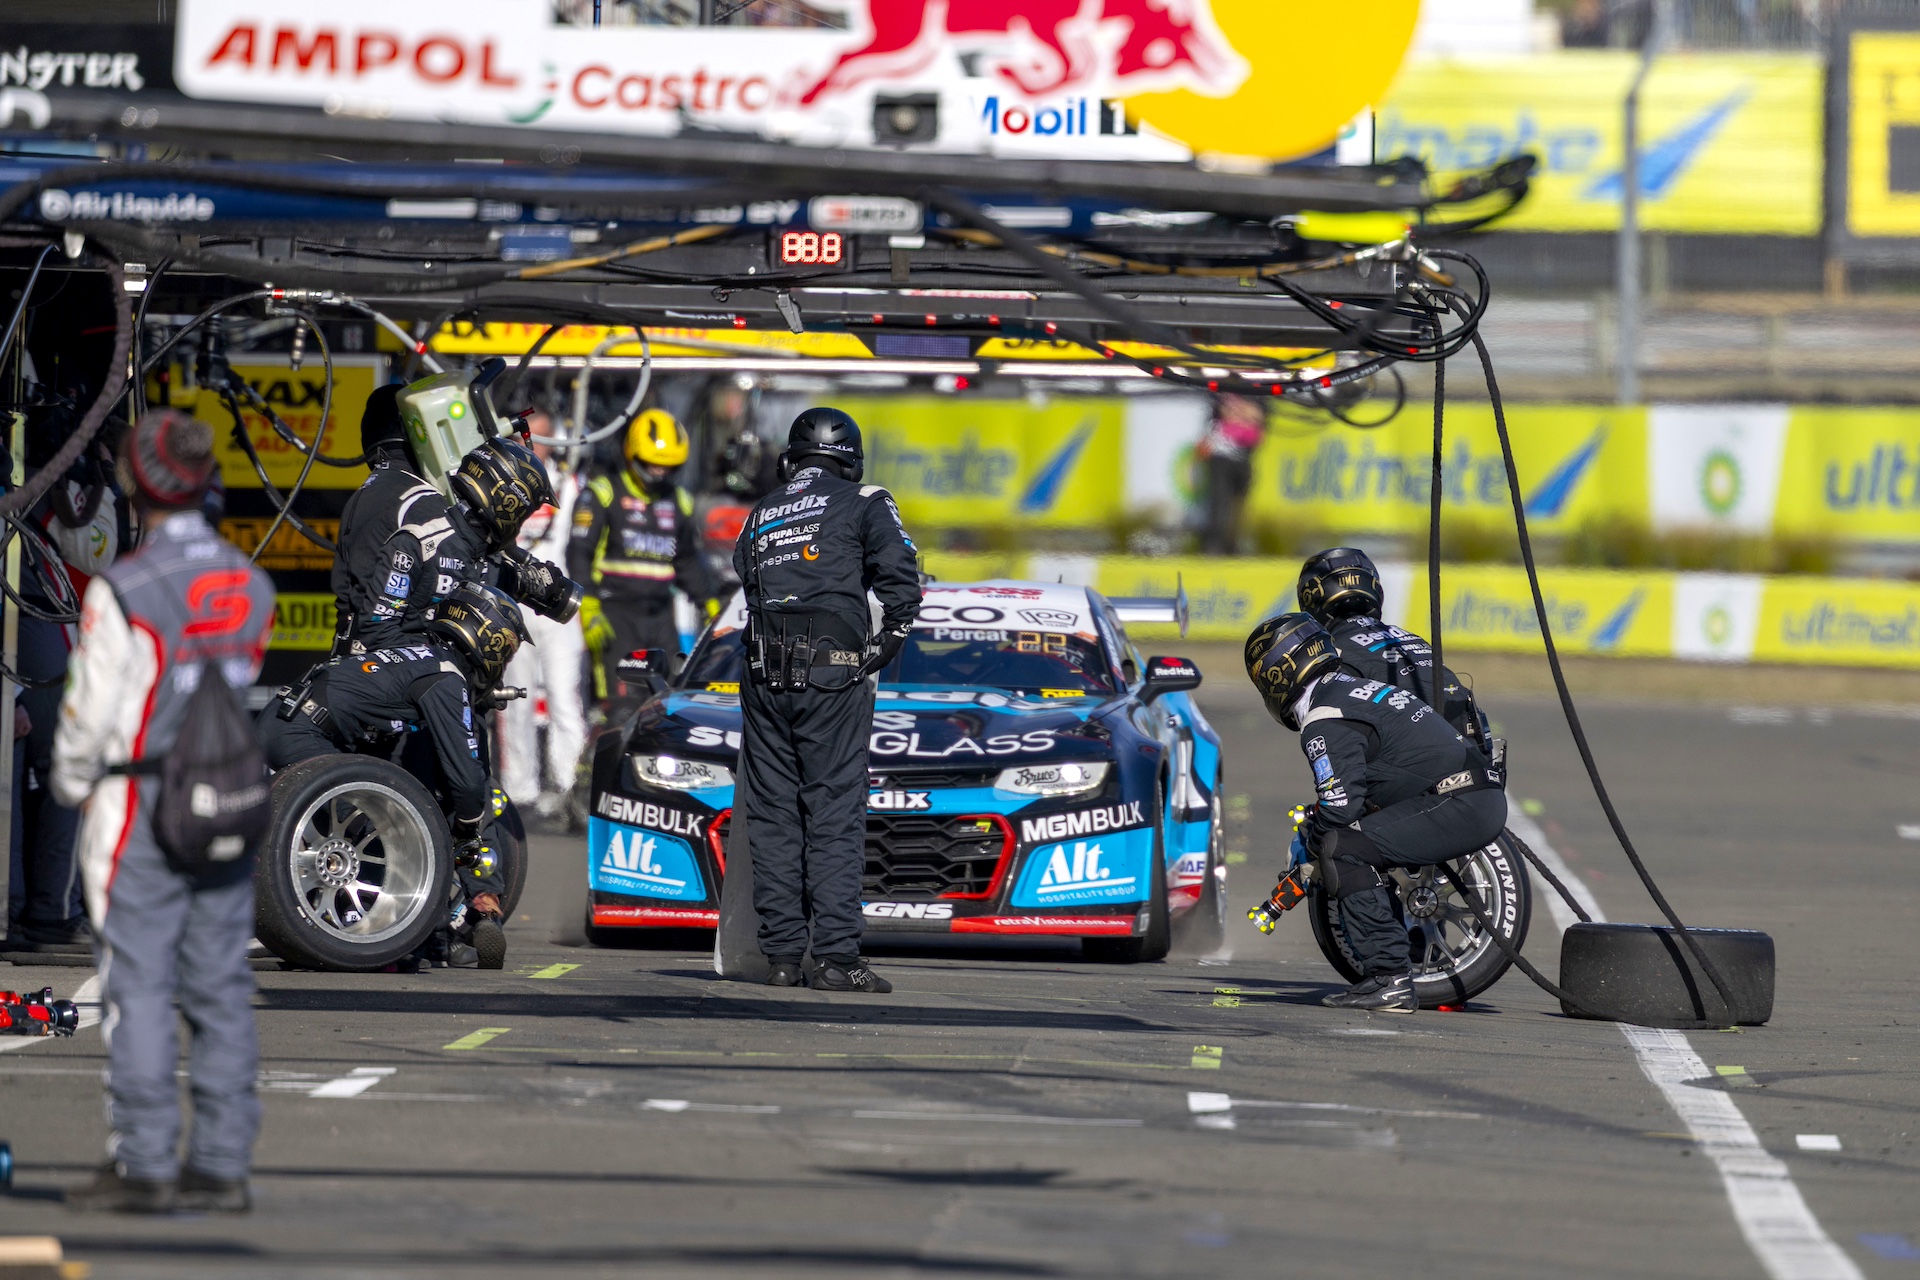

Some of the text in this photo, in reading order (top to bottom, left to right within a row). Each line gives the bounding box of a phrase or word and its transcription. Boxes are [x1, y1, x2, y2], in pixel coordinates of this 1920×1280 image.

[204, 22, 518, 88] AMPOL
[571, 64, 772, 112] Castro
[979, 96, 1087, 137] Mobil
[781, 231, 843, 265] 88.8
[751, 494, 830, 529] endix
[782, 507, 825, 525] RACING
[768, 522, 820, 542] SUPAGLASS
[775, 533, 813, 547] RACING
[752, 551, 800, 575] cregas
[1338, 574, 1361, 588] UNIT
[448, 604, 469, 621] UNIT
[933, 628, 1008, 642] Percat
[1306, 640, 1326, 657] UNIT
[1154, 667, 1196, 677] Red Hat
[1307, 739, 1326, 760] PPG
[866, 790, 929, 809] dix
[597, 791, 705, 838] MGMBULK
[1021, 801, 1144, 843] MGMBULK
[602, 829, 663, 876] Alt.
[1040, 841, 1111, 886] Alt.
[598, 873, 684, 897] HOSPITALITY GROUP
[1037, 884, 1137, 904] HOSPITALITY GROUP
[1484, 842, 1518, 940] DUNLOP
[600, 908, 720, 920] retraVision.com.au
[993, 916, 1127, 927] retraVision.com.au
